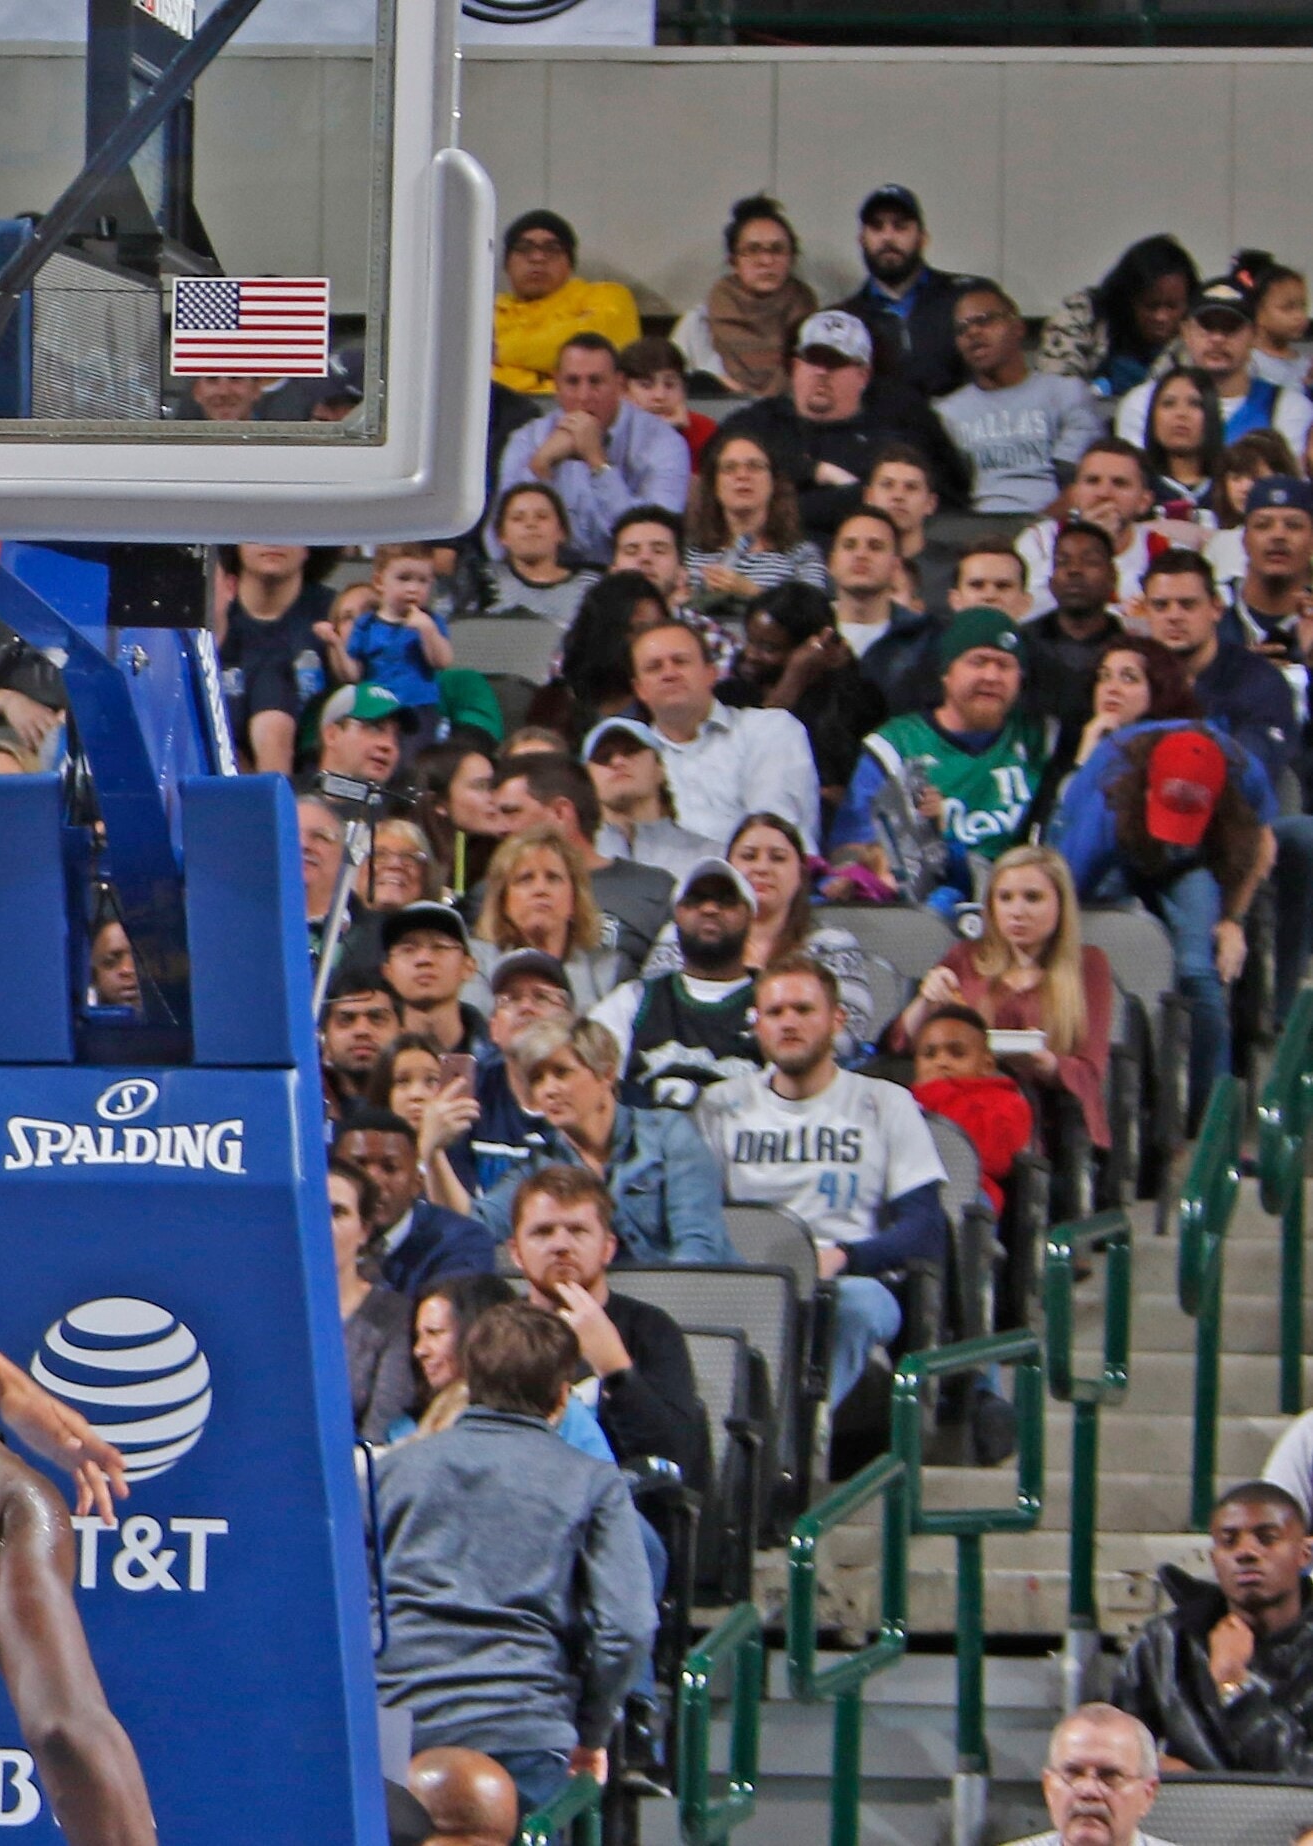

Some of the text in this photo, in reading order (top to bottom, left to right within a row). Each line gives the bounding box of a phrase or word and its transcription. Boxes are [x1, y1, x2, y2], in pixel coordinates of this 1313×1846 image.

[5, 1116, 247, 1174] SPALDING
[734, 1126, 862, 1163] DALLAS
[818, 1172, 860, 1209] 41
[69, 1515, 229, 1591] T&T
